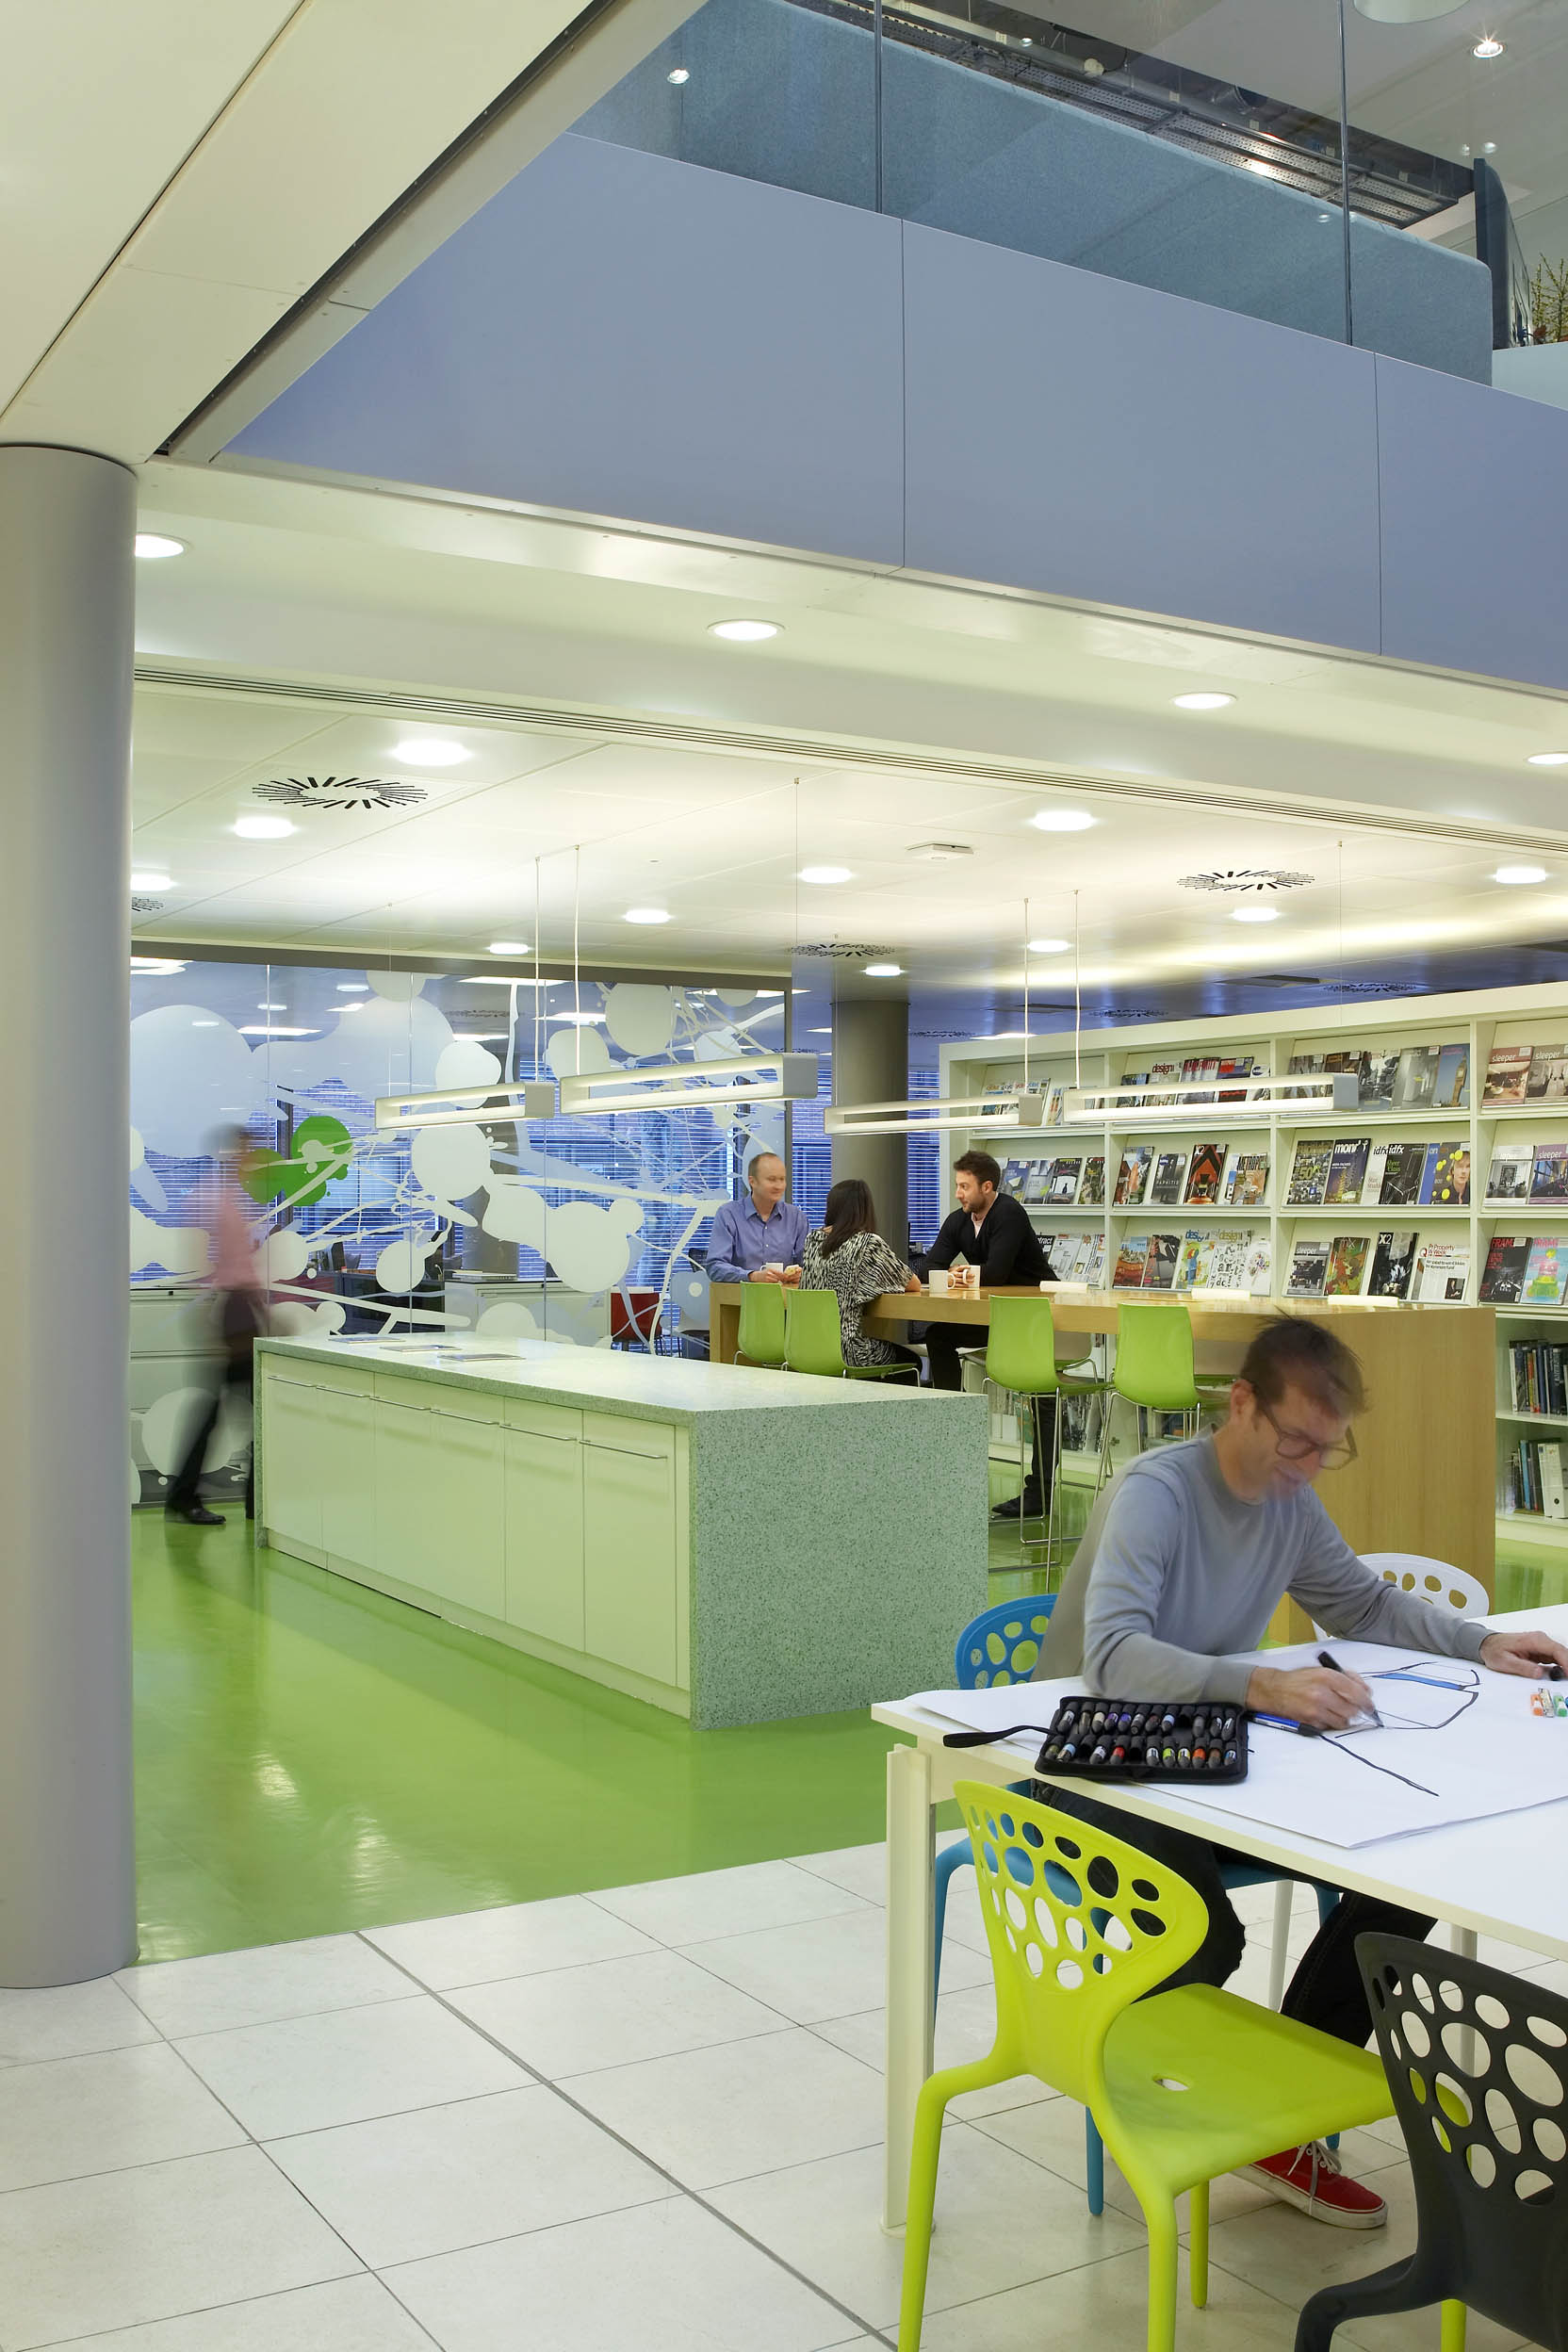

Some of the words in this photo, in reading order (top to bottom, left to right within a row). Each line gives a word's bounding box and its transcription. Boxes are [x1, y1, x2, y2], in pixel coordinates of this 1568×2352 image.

[1492, 1054, 1516, 1063] sleeper
[1535, 1051, 1561, 1061] sleeper
[1152, 1062, 1174, 1075] design
[1194, 1145, 1205, 1155] X2
[1388, 1144, 1405, 1154] idfx
[1538, 1151, 1562, 1161] sleeper
[1379, 1233, 1392, 1245] X2
[1492, 1238, 1514, 1249] FRAM
[1296, 1247, 1317, 1256] sleeper
